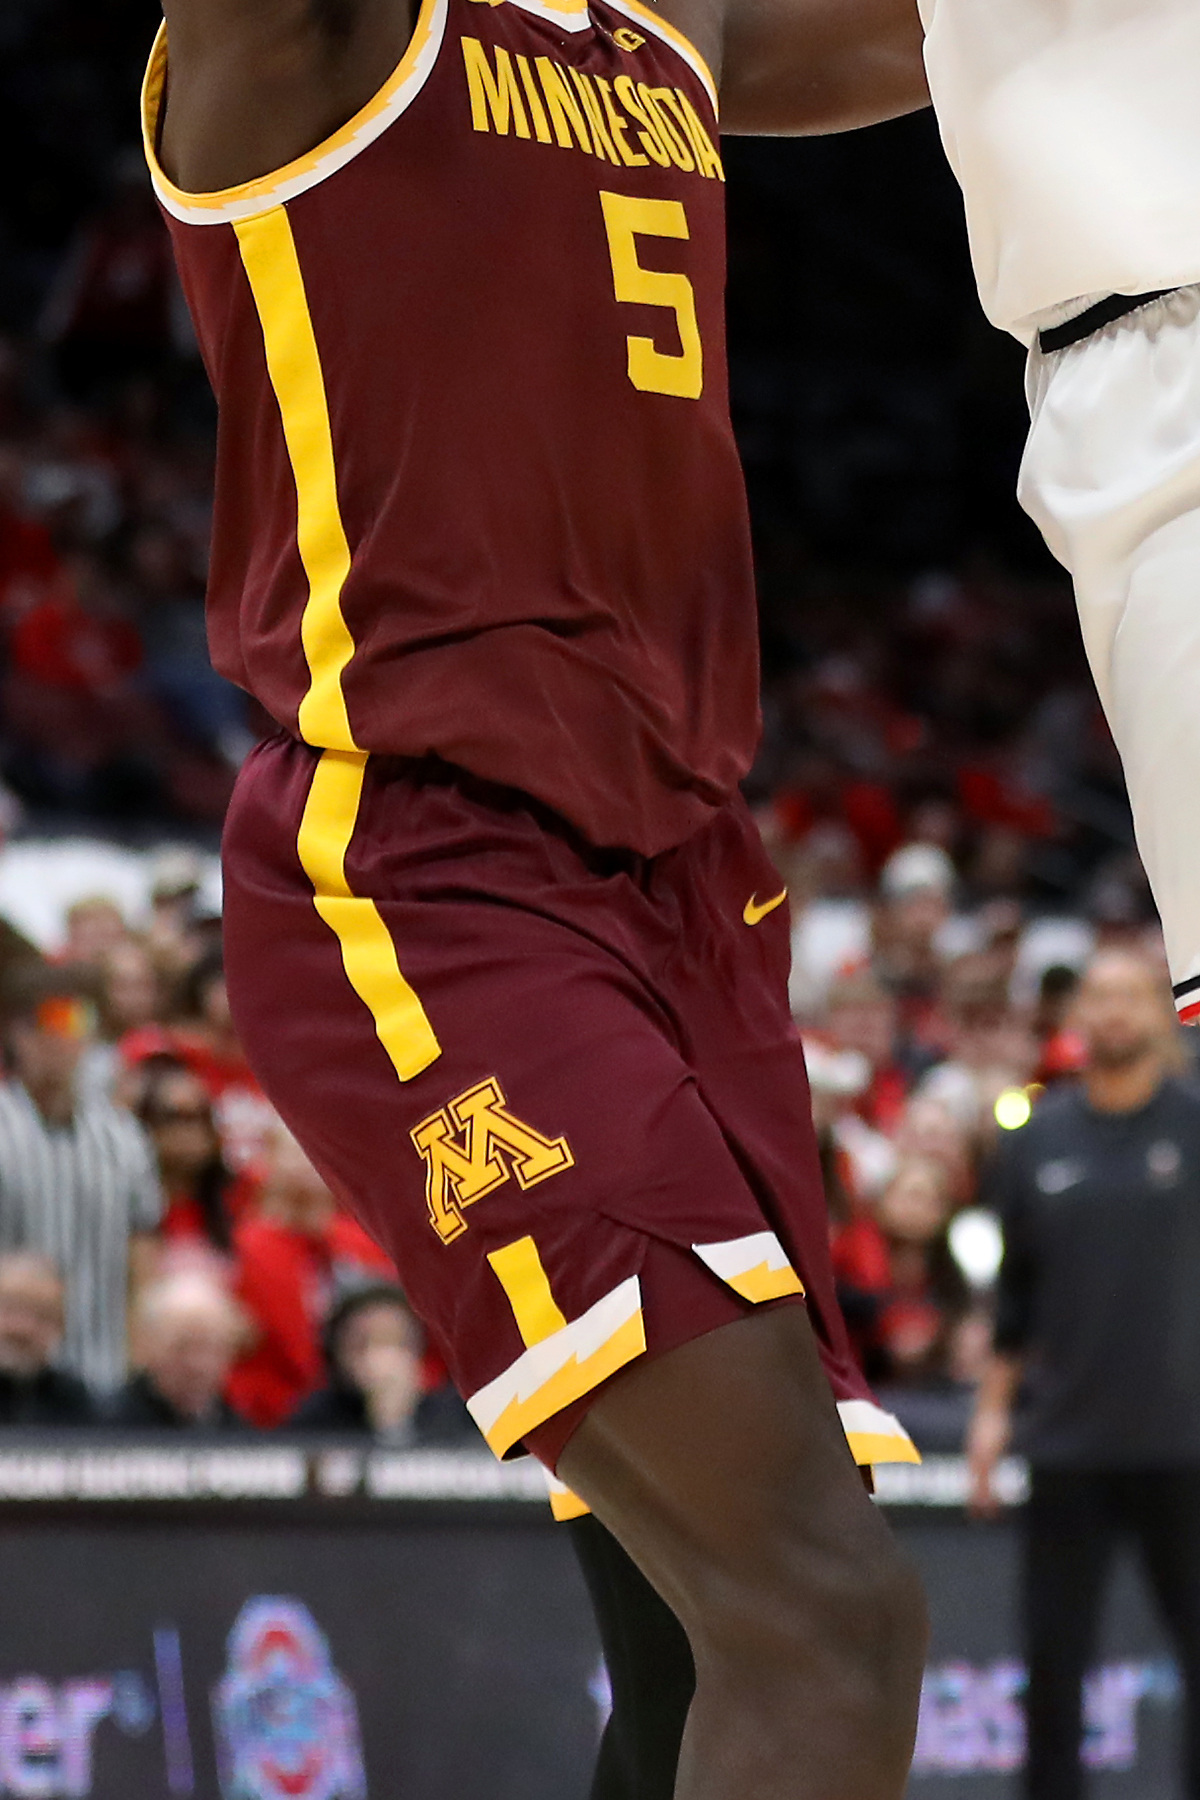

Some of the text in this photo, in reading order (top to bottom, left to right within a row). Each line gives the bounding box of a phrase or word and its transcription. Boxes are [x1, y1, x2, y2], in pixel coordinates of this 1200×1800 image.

[460, 36, 726, 182] MINNESOTA
[599, 190, 704, 400] 5
[408, 1075, 576, 1246] M
